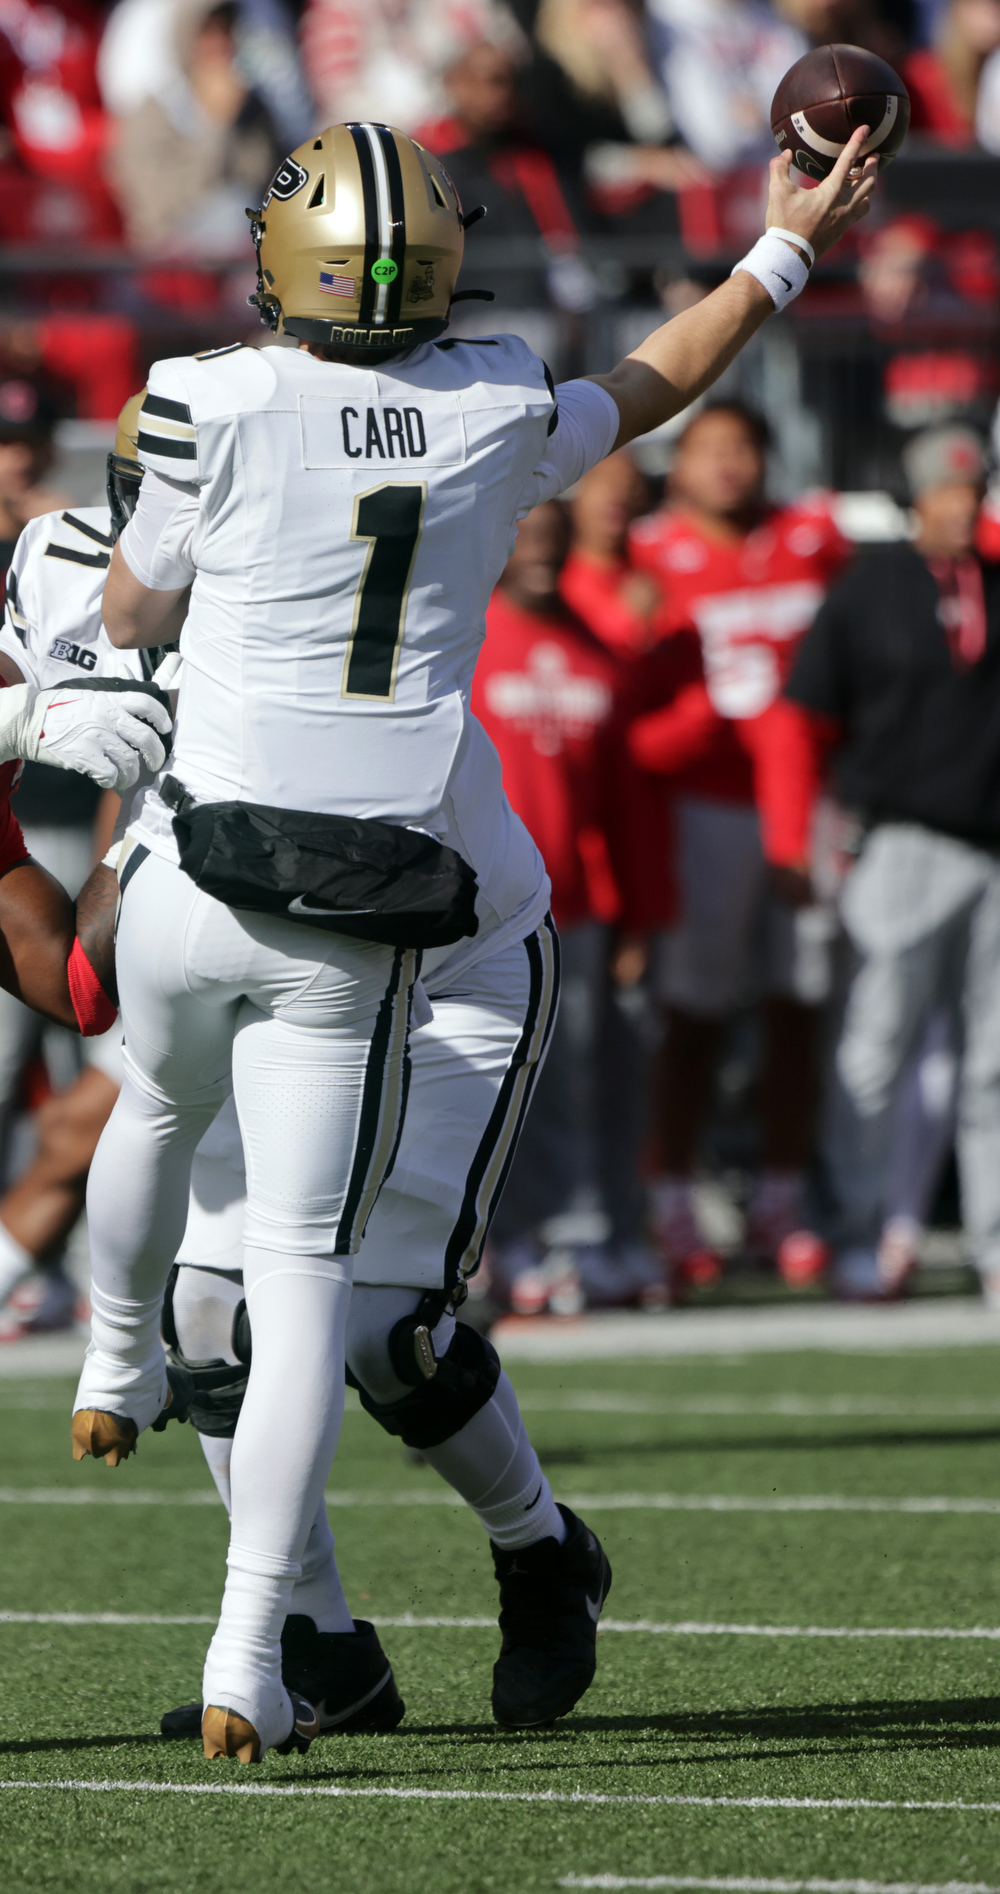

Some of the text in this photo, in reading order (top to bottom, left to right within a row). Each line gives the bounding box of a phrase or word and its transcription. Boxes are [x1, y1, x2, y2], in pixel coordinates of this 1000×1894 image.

[374, 266, 396, 276] C2P
[330, 326, 414, 345] BOILER UP
[340, 406, 428, 459] CARD
[340, 480, 428, 703] 1
